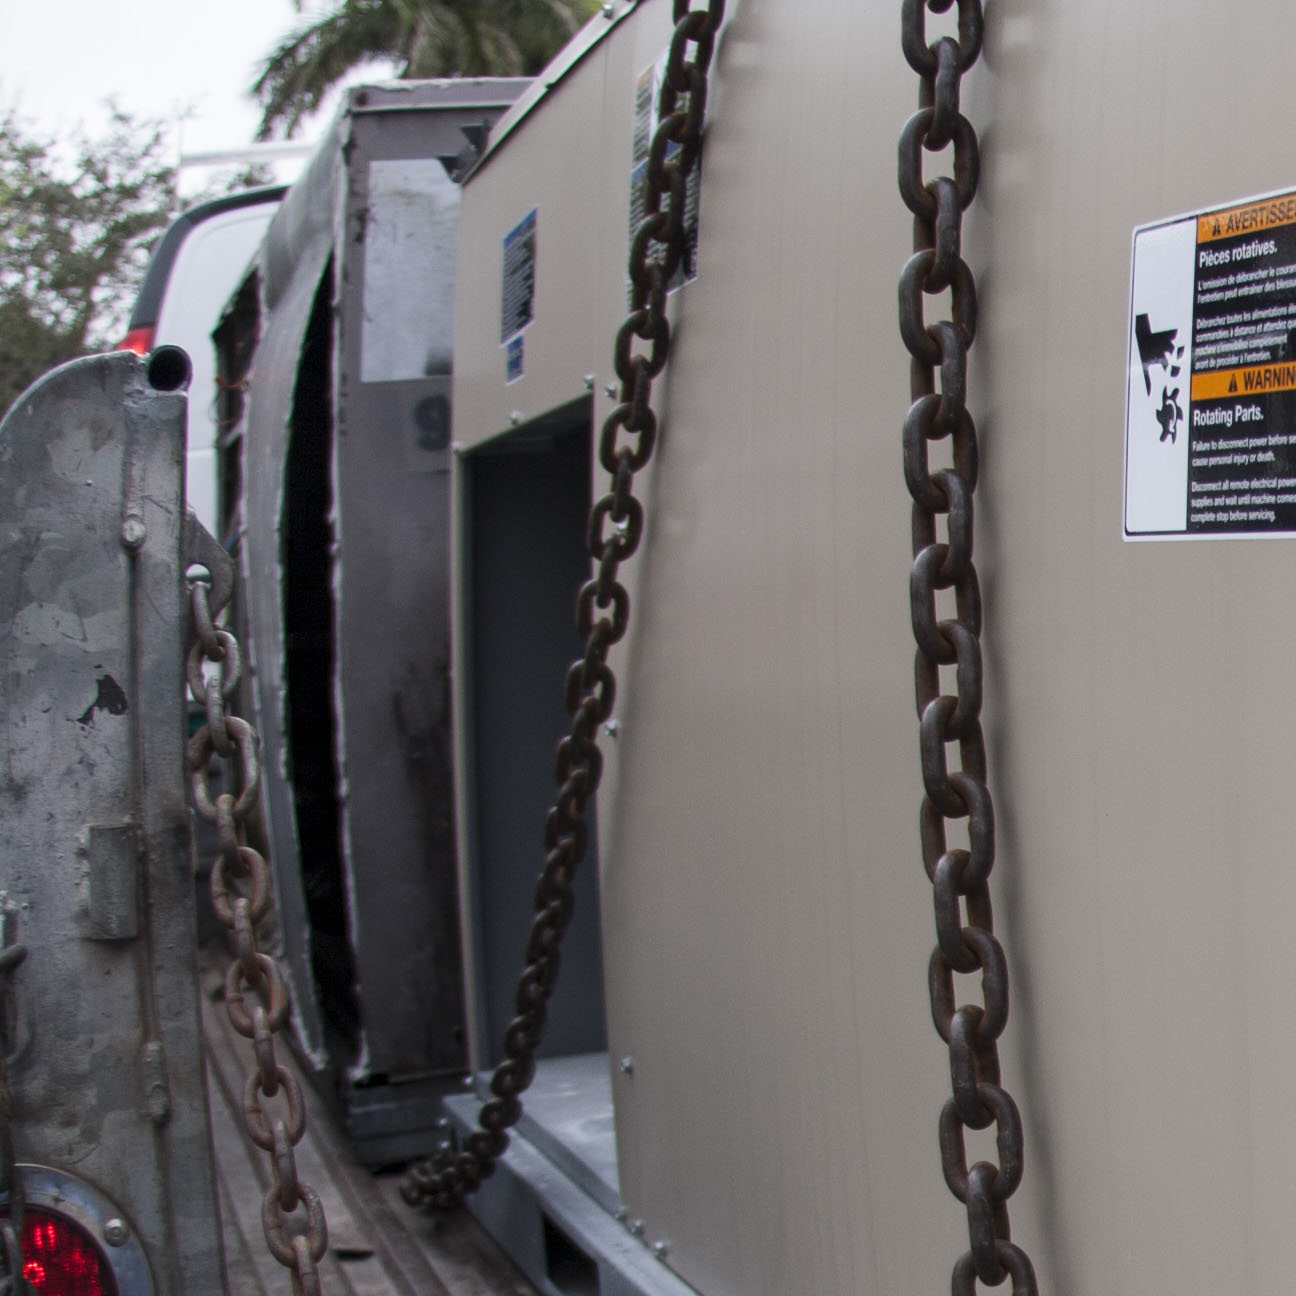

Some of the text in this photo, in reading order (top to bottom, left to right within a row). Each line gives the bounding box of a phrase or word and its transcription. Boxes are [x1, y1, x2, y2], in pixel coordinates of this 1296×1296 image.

[1199, 239, 1278, 268] Pièces rotatives.
[1193, 404, 1264, 428] Rotating Parts.
[1249, 436, 1268, 451] power
[1268, 433, 1287, 447] before
[1250, 453, 1257, 462] or
